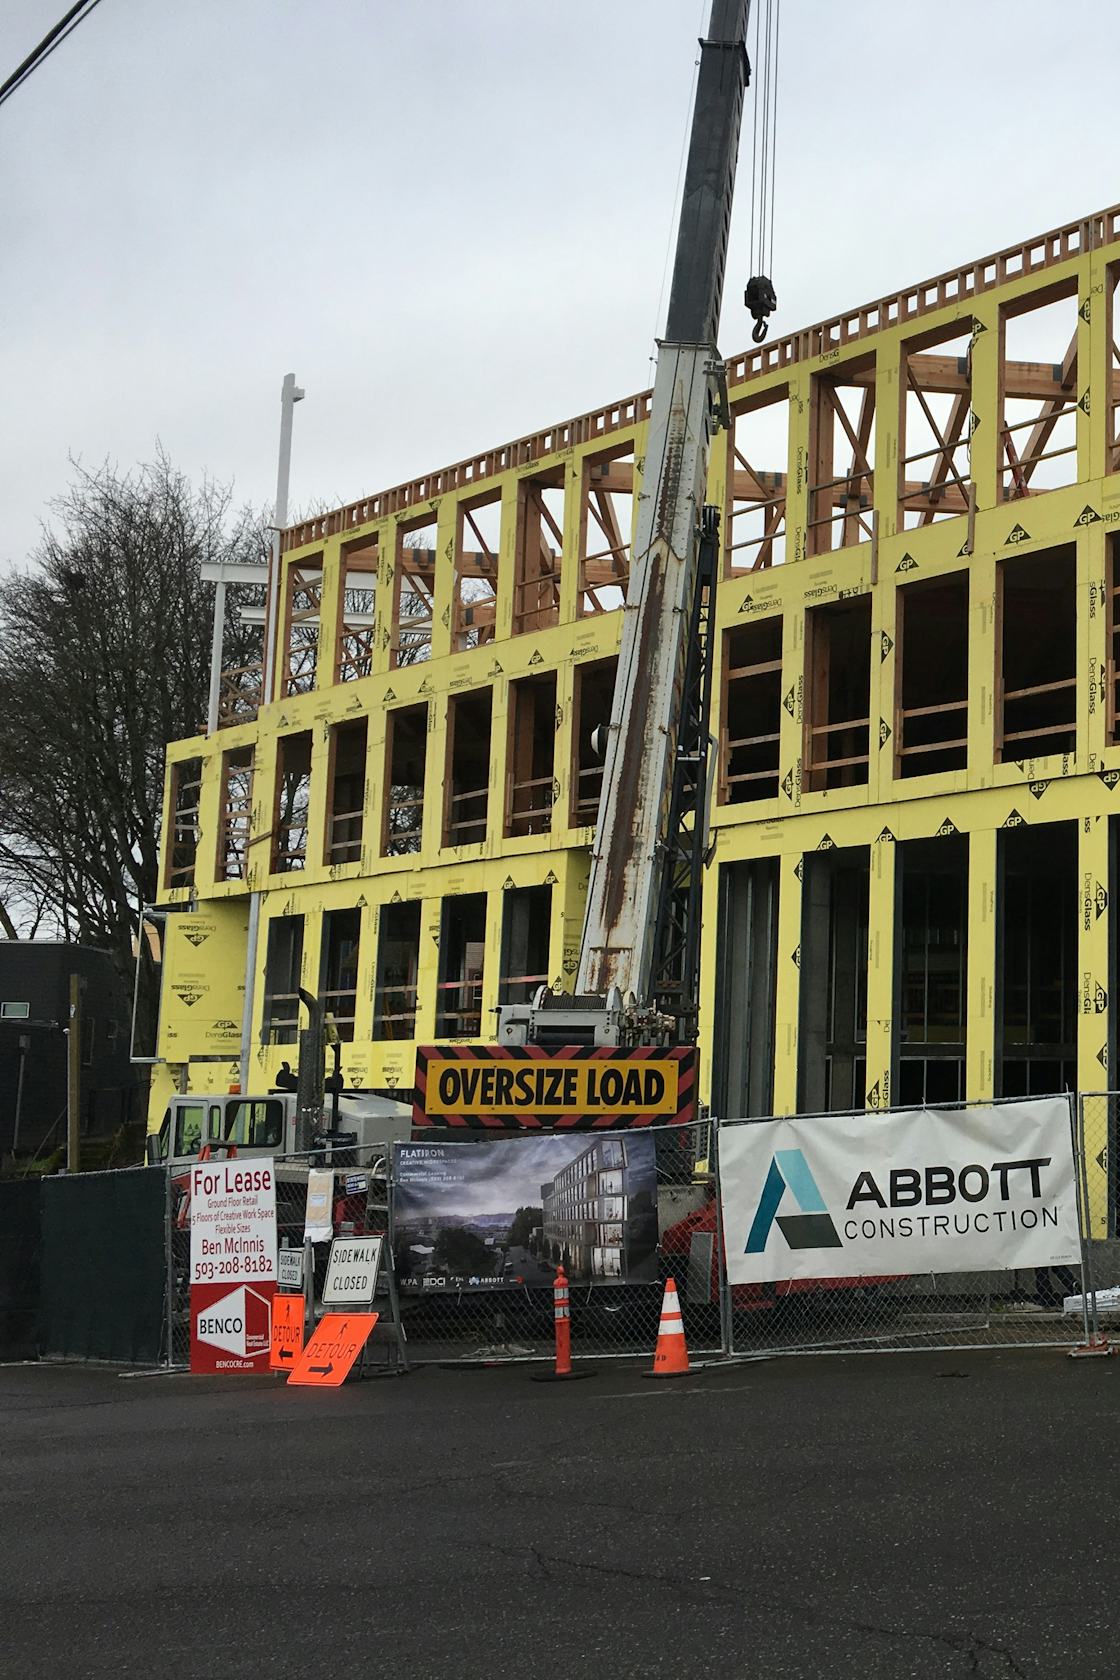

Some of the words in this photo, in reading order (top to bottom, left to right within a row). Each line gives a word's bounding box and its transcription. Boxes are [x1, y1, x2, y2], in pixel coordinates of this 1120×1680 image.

[1079, 511, 1096, 524] GP
[1010, 531, 1024, 542] GP
[899, 559, 914, 570] GP
[803, 584, 838, 598] DensGlass
[882, 635, 889, 656] GP
[531, 655, 541, 663] GP
[1089, 657, 1097, 714] DensGlass
[787, 694, 794, 711] GP
[880, 722, 886, 742] GP
[786, 775, 792, 795] GP
[1103, 772, 1120, 783] GP
[1031, 780, 1047, 792] GP
[1007, 816, 1022, 827] GP
[941, 825, 954, 835] GP
[820, 840, 833, 850] GP
[879, 833, 892, 844] GP
[1084, 873, 1092, 931] DensGlass
[438, 1068, 578, 1106] OVERSIZE
[587, 1068, 665, 1106] LOAD
[400, 1149, 444, 1158] FLATIRON
[194, 1170, 220, 1196] For
[225, 1168, 271, 1193] Lease
[846, 1157, 1051, 1210] ABBOTT
[844, 1206, 1059, 1240] CONSTRUCTION
[202, 1239, 221, 1255] Ben
[225, 1235, 264, 1254] McInnis
[333, 1249, 377, 1264] SIDEWALK
[195, 1255, 272, 1280] 503-208-8182
[333, 1276, 368, 1291] CLOSED
[200, 1318, 242, 1334] BENCO
[274, 1325, 300, 1342] DETOUR
[307, 1343, 356, 1359] DETOUR
